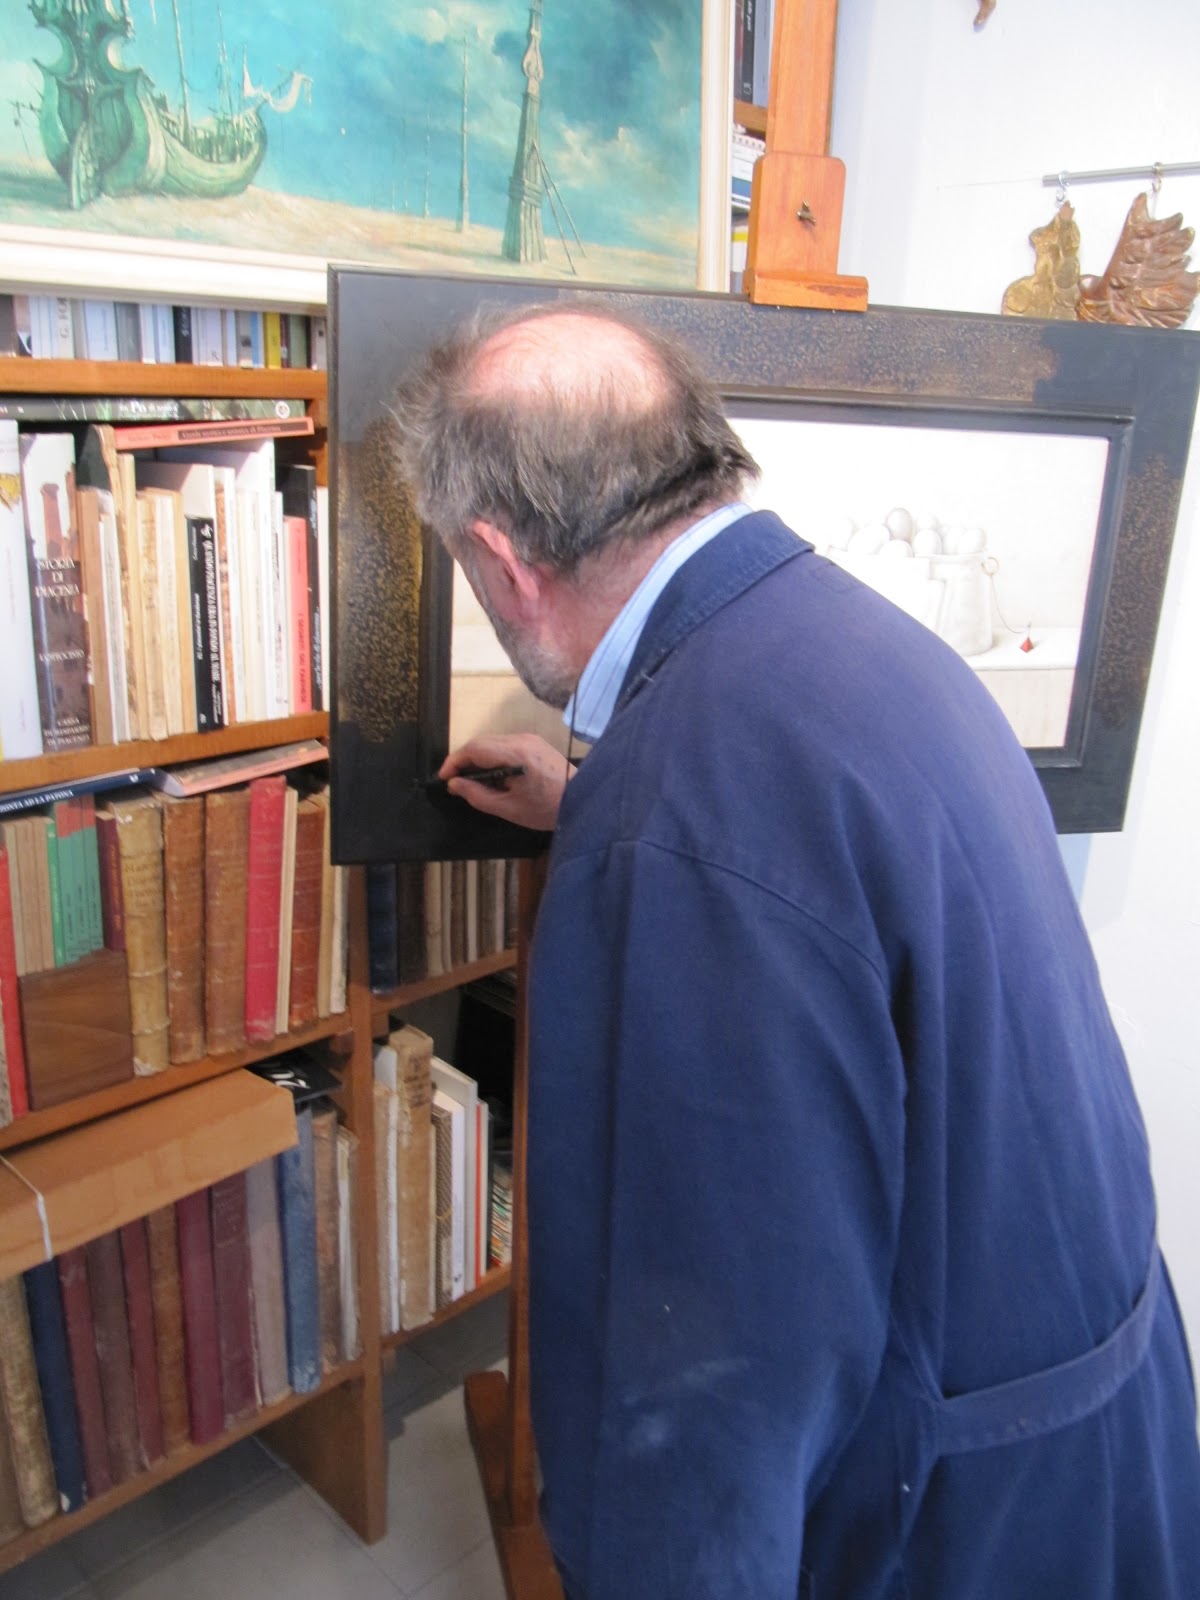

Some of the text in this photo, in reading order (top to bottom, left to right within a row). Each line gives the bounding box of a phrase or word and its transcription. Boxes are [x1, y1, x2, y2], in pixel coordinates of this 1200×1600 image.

[37, 556, 75, 570] STORIA
[52, 571, 64, 583] DI
[35, 584, 80, 599] PIACENZA
